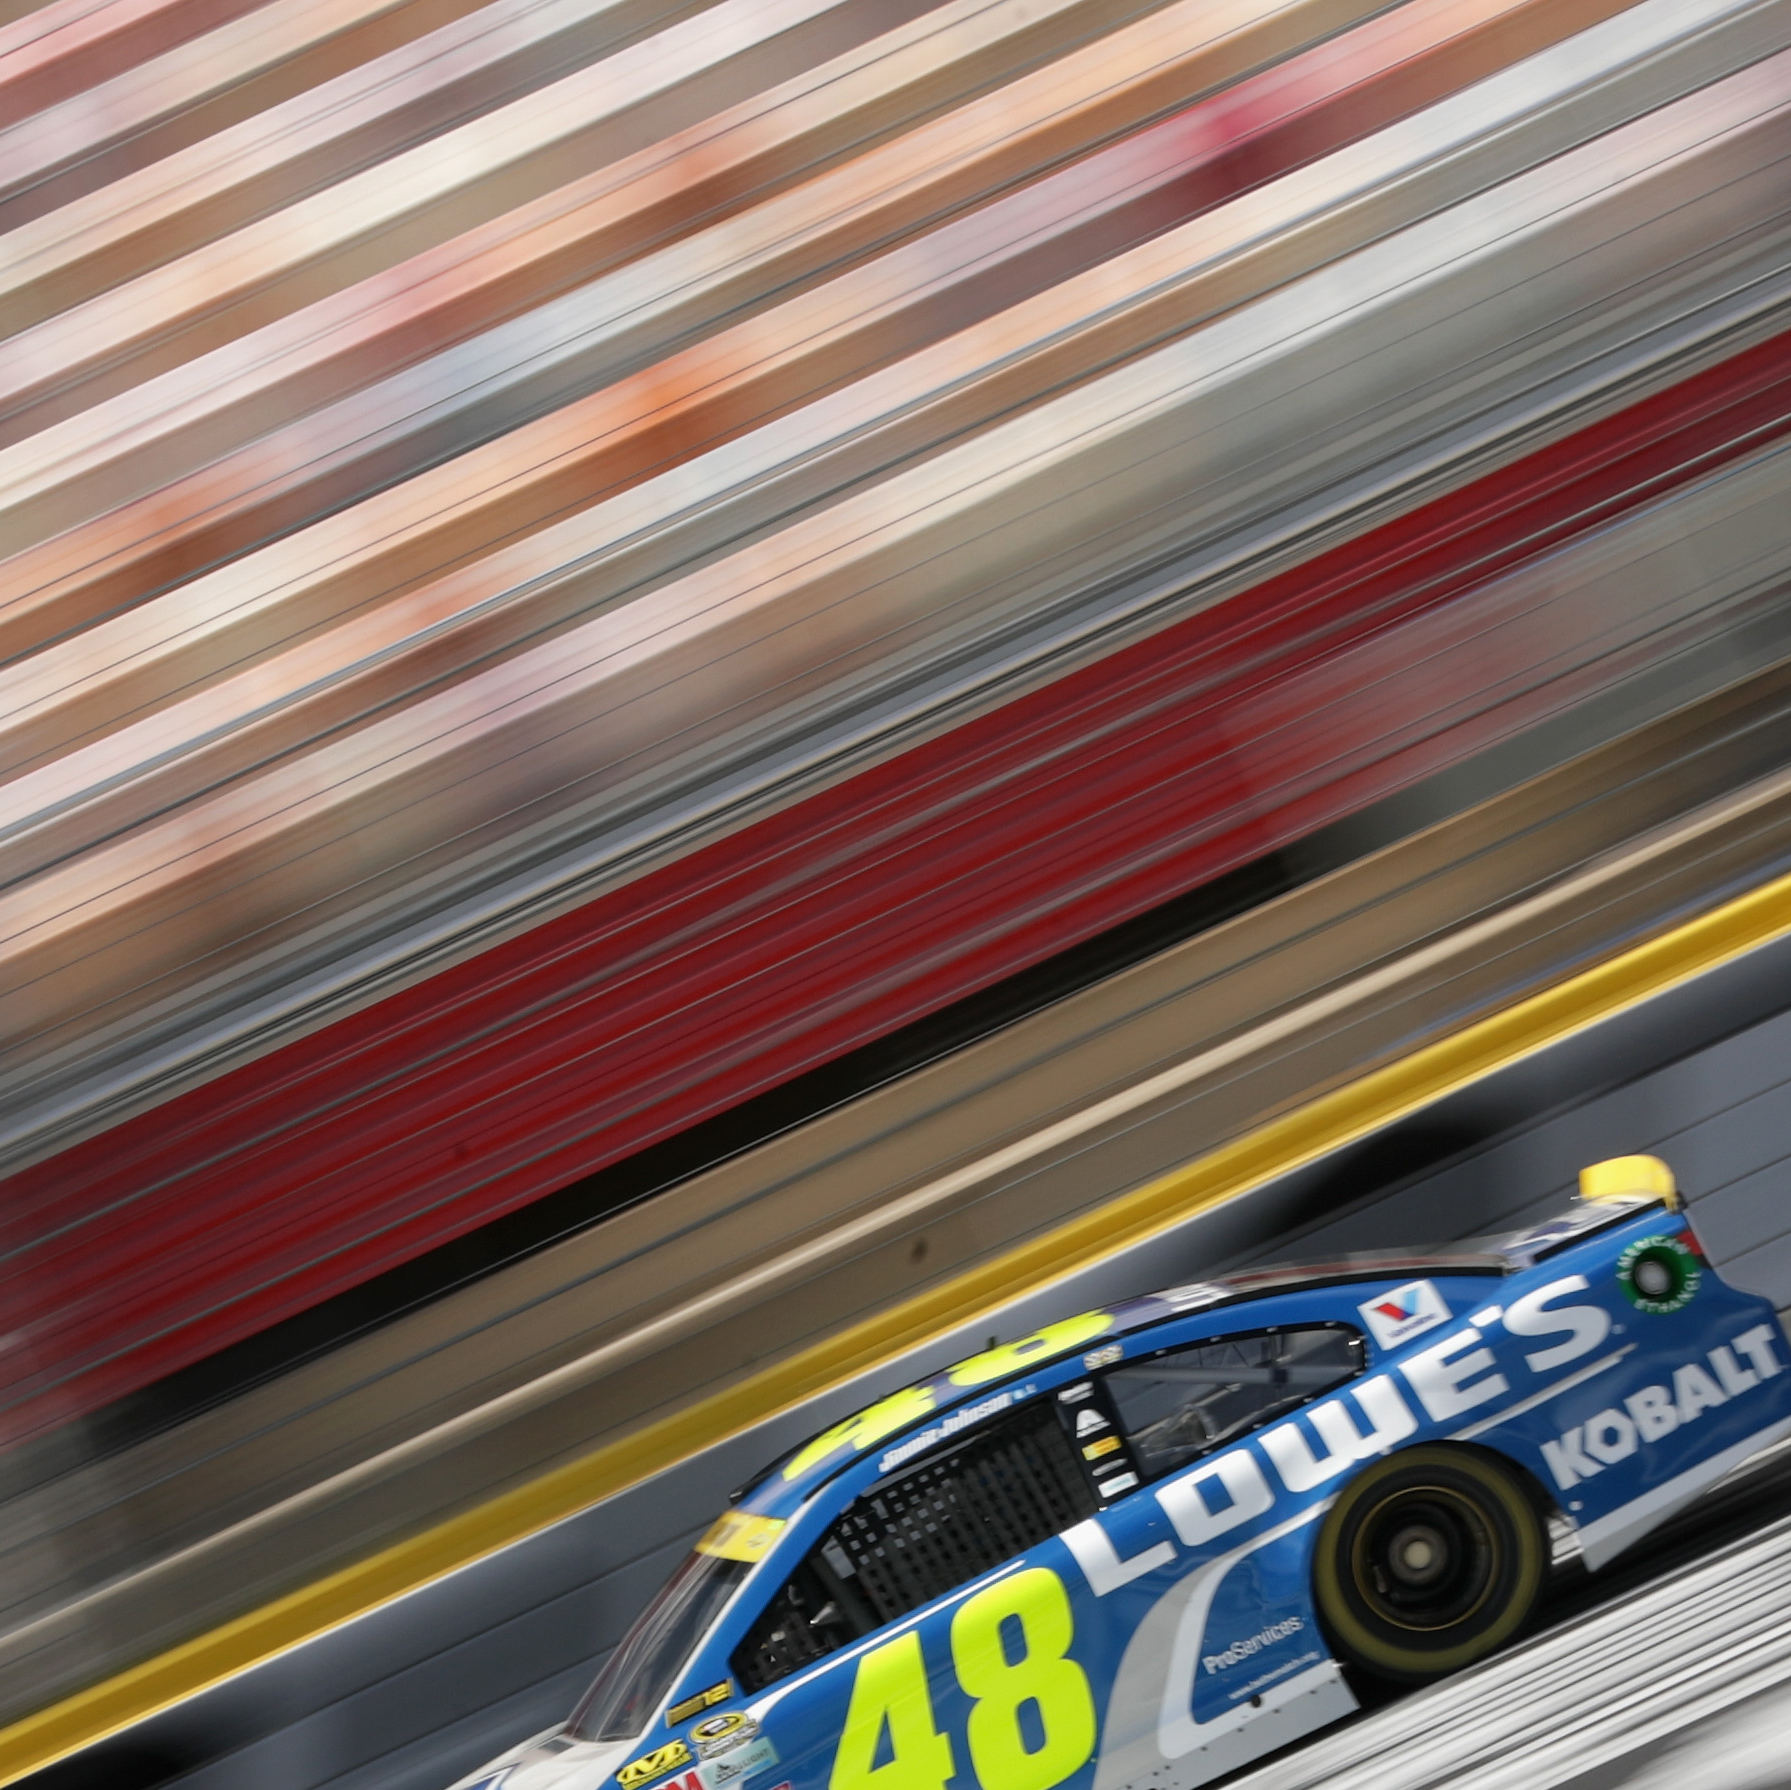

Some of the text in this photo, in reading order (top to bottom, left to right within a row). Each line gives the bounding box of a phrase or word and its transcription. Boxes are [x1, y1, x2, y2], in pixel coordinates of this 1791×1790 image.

[1059, 1275, 1611, 1597] LOWE'S
[1540, 1322, 1787, 1491] KOBALT
[1202, 1616, 1305, 1676] ProServices
